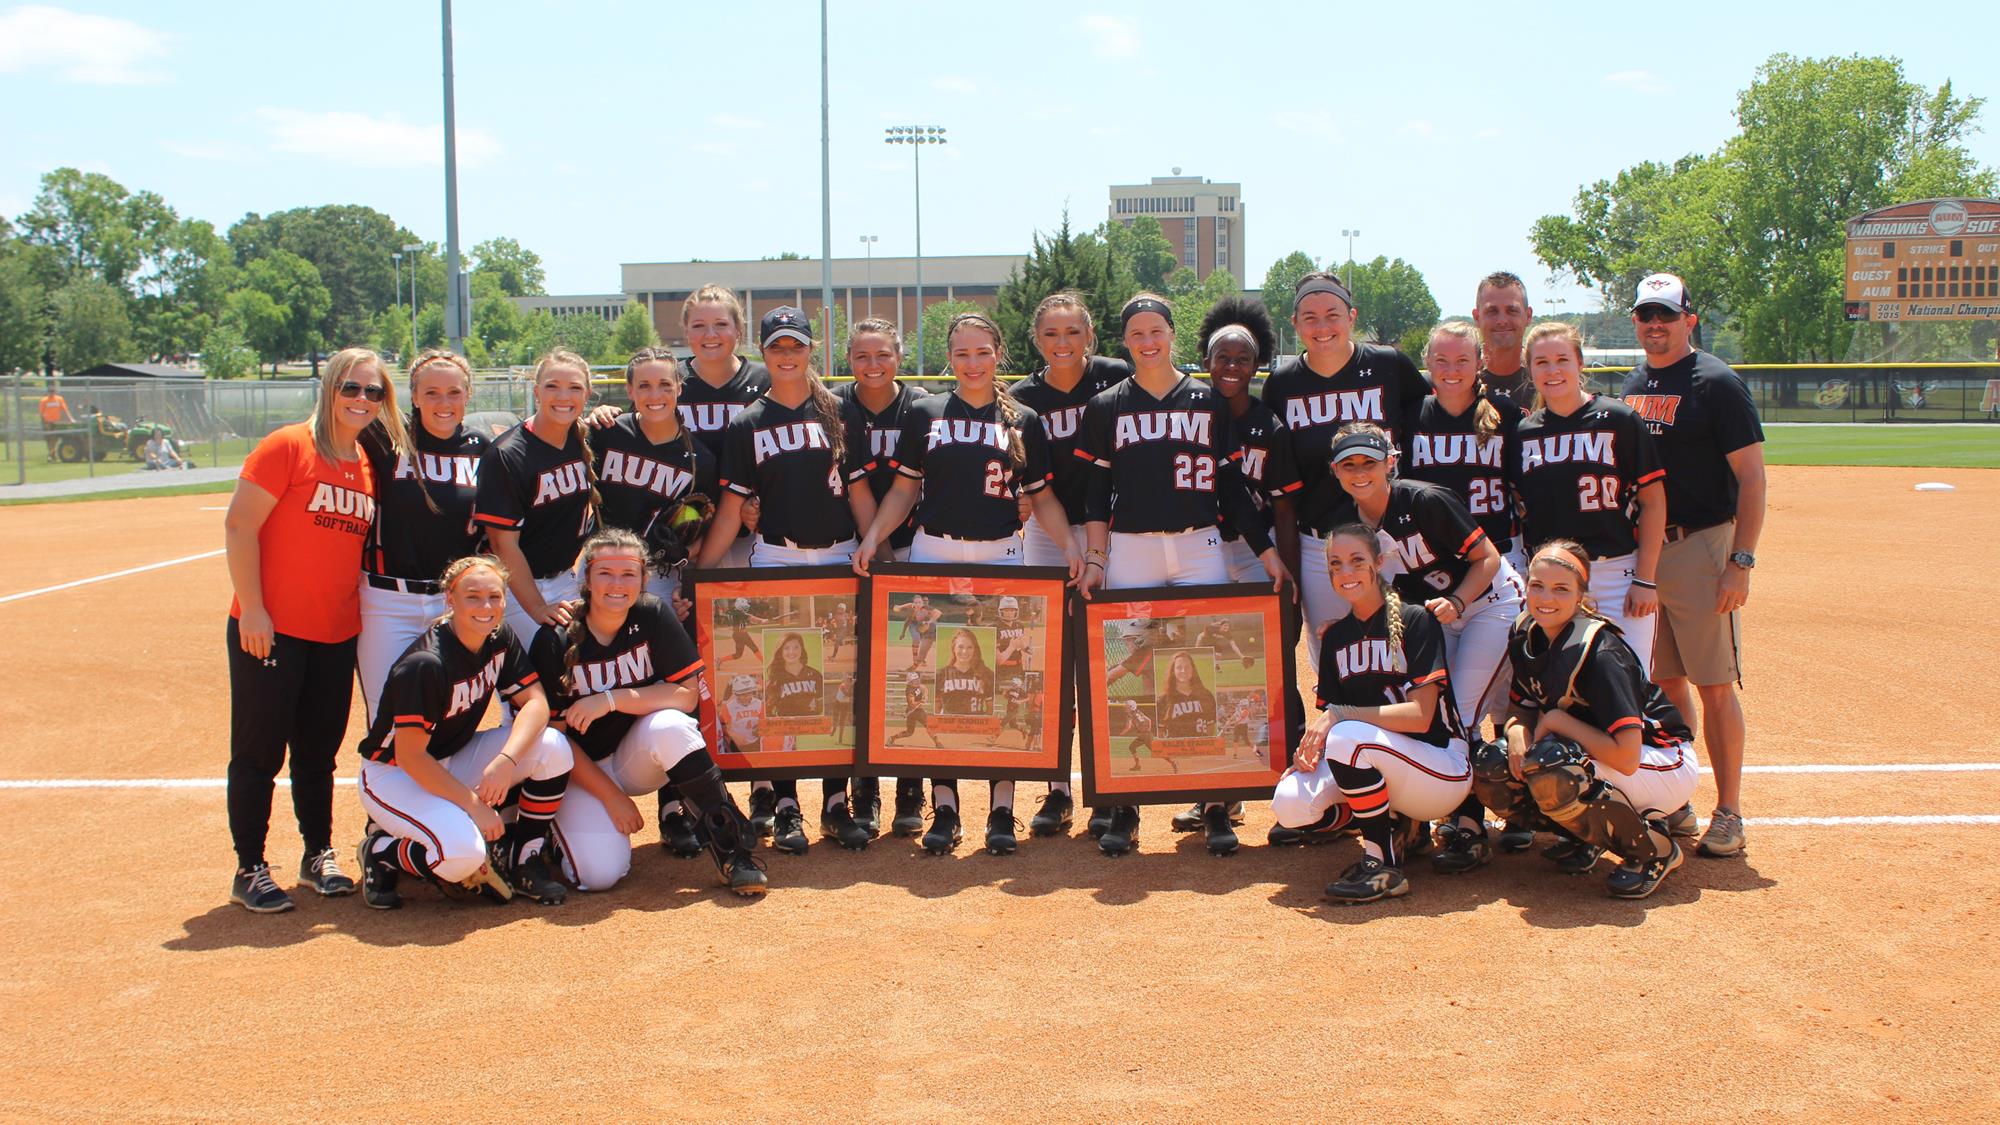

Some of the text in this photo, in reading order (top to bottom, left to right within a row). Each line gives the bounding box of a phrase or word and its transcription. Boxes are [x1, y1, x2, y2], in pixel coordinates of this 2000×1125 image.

[1850, 219, 2000, 236] WARHAWKS SOF
[1854, 243, 1999, 256] BALL STRIKE OUT
[1852, 270, 1893, 281] GUEST
[1862, 286, 1892, 297] AUM
[1907, 303, 2000, 318] National Champi
[1286, 387, 1385, 430] AUM
[1114, 410, 1213, 450] AUM
[1411, 433, 1505, 468] AUM
[1521, 431, 1616, 474] AUM
[395, 452, 481, 488] AUM
[600, 449, 694, 500] AUM
[828, 463, 843, 496] 4
[1175, 453, 1216, 491] 22
[306, 481, 377, 526] AUM
[1468, 477, 1506, 514] 25
[1578, 473, 1620, 512] 20
[313, 513, 369, 537] SOFTBALL
[568, 643, 655, 698] AUM
[781, 680, 817, 698] AUM
